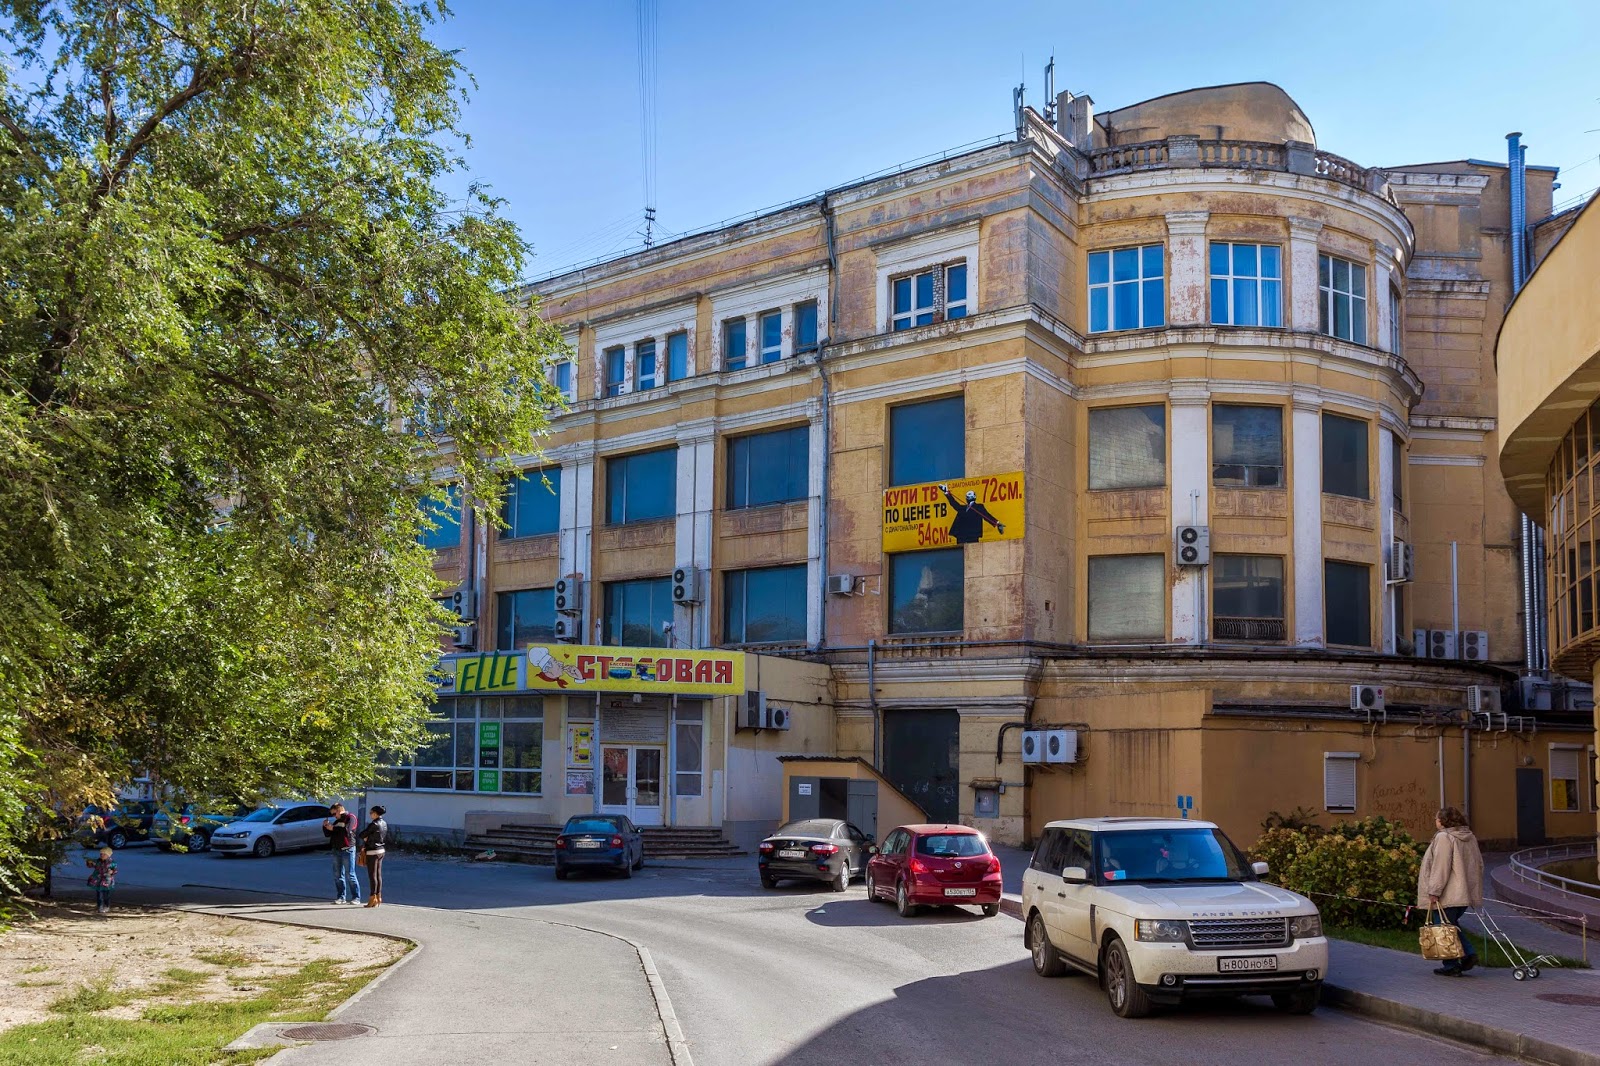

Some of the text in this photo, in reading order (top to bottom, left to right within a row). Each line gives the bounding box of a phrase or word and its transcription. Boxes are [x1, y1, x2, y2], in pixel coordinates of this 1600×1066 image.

[952, 479, 980, 488] ДИАГОНАЛЬЮ
[885, 485, 938, 507] КУПИ ТВ
[885, 502, 947, 523] ПО ЦЕНЕ ТВ
[888, 524, 918, 534] ДИАГОНАЛЬЮ
[460, 648, 522, 694] ELLE
[577, 655, 733, 684] СТОВАЯ
